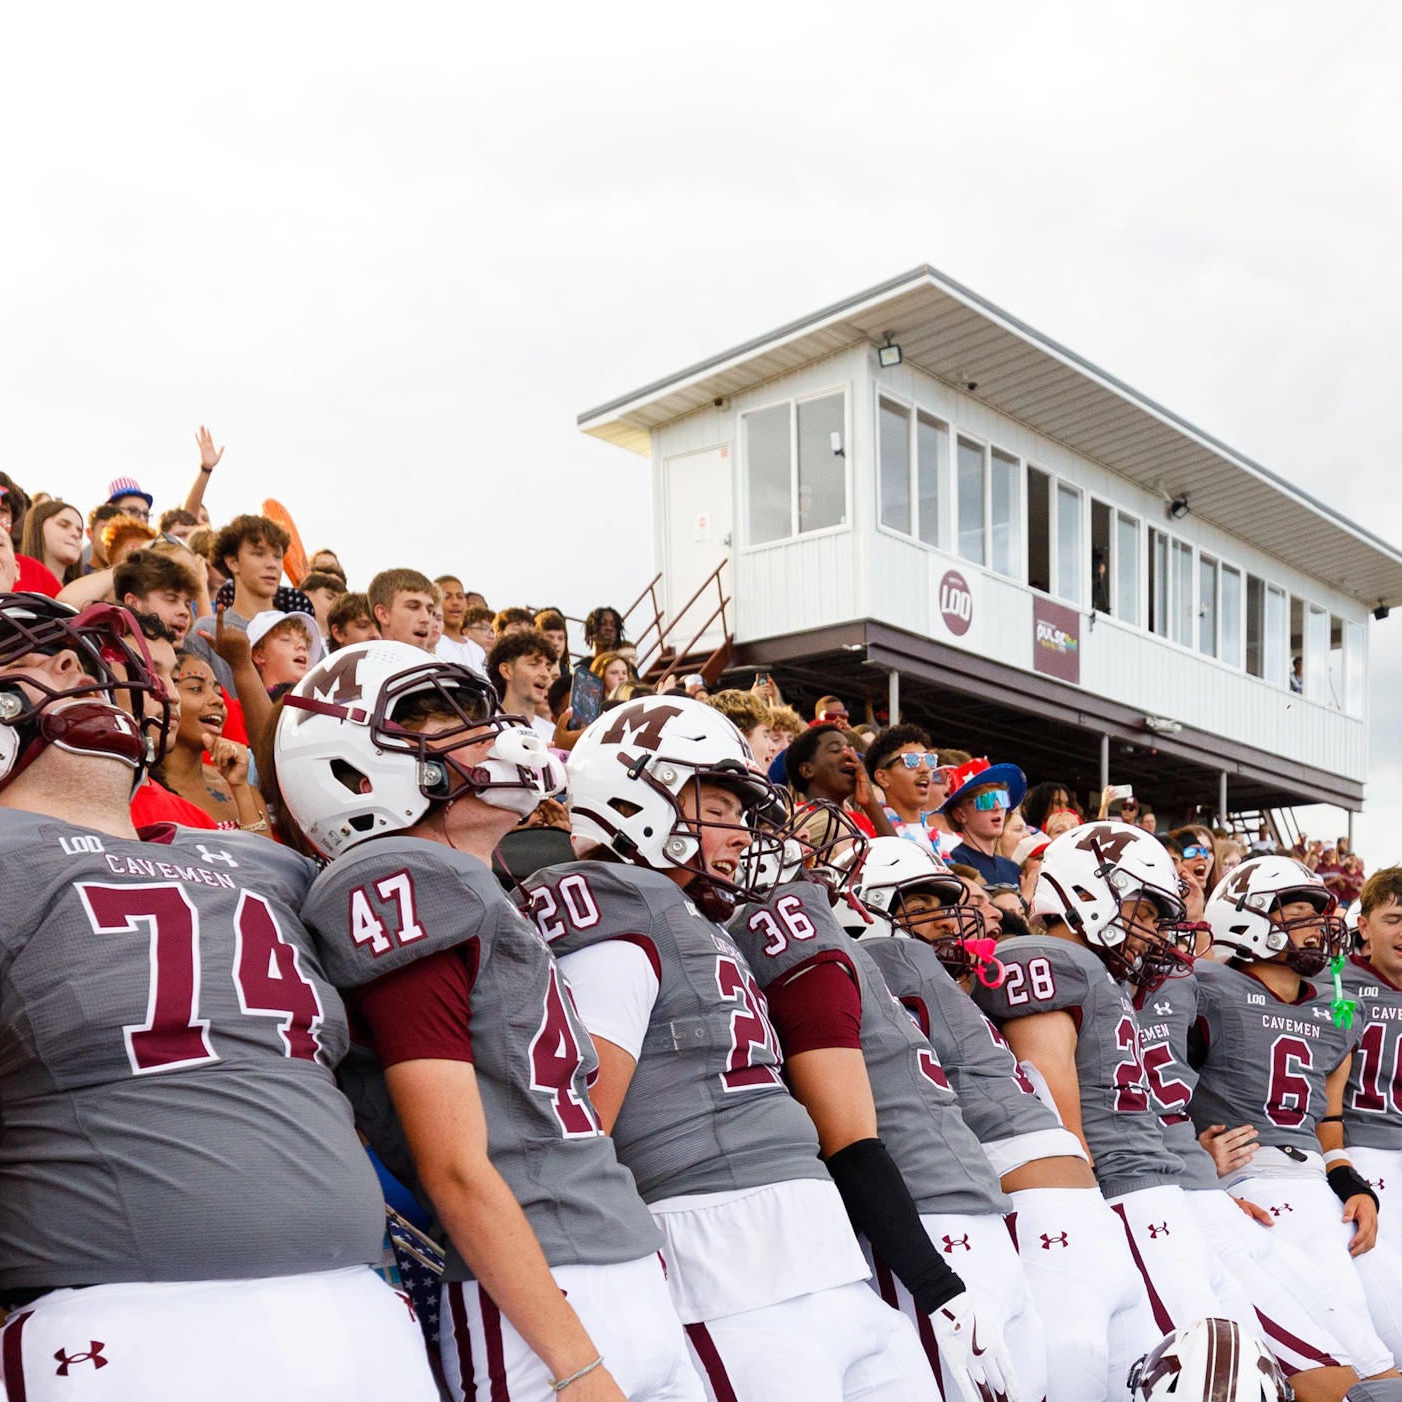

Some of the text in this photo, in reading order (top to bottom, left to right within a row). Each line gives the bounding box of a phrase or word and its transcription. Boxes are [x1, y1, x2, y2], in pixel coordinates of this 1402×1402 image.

[941, 584, 973, 622] LOD
[297, 650, 368, 726] M
[600, 703, 684, 750] M
[104, 853, 237, 890] CAVEMEN
[1075, 826, 1139, 862] M
[349, 868, 427, 958] 47
[529, 873, 601, 943] 20
[748, 894, 817, 958] 36
[73, 882, 325, 1075] 74
[1004, 956, 1057, 1008] 28
[528, 957, 604, 1139] 4
[1139, 1023, 1170, 1042] EMEN
[1262, 1014, 1320, 1038] CAVEMEN
[1141, 1041, 1193, 1128] 5
[1264, 1033, 1313, 1128] 6
